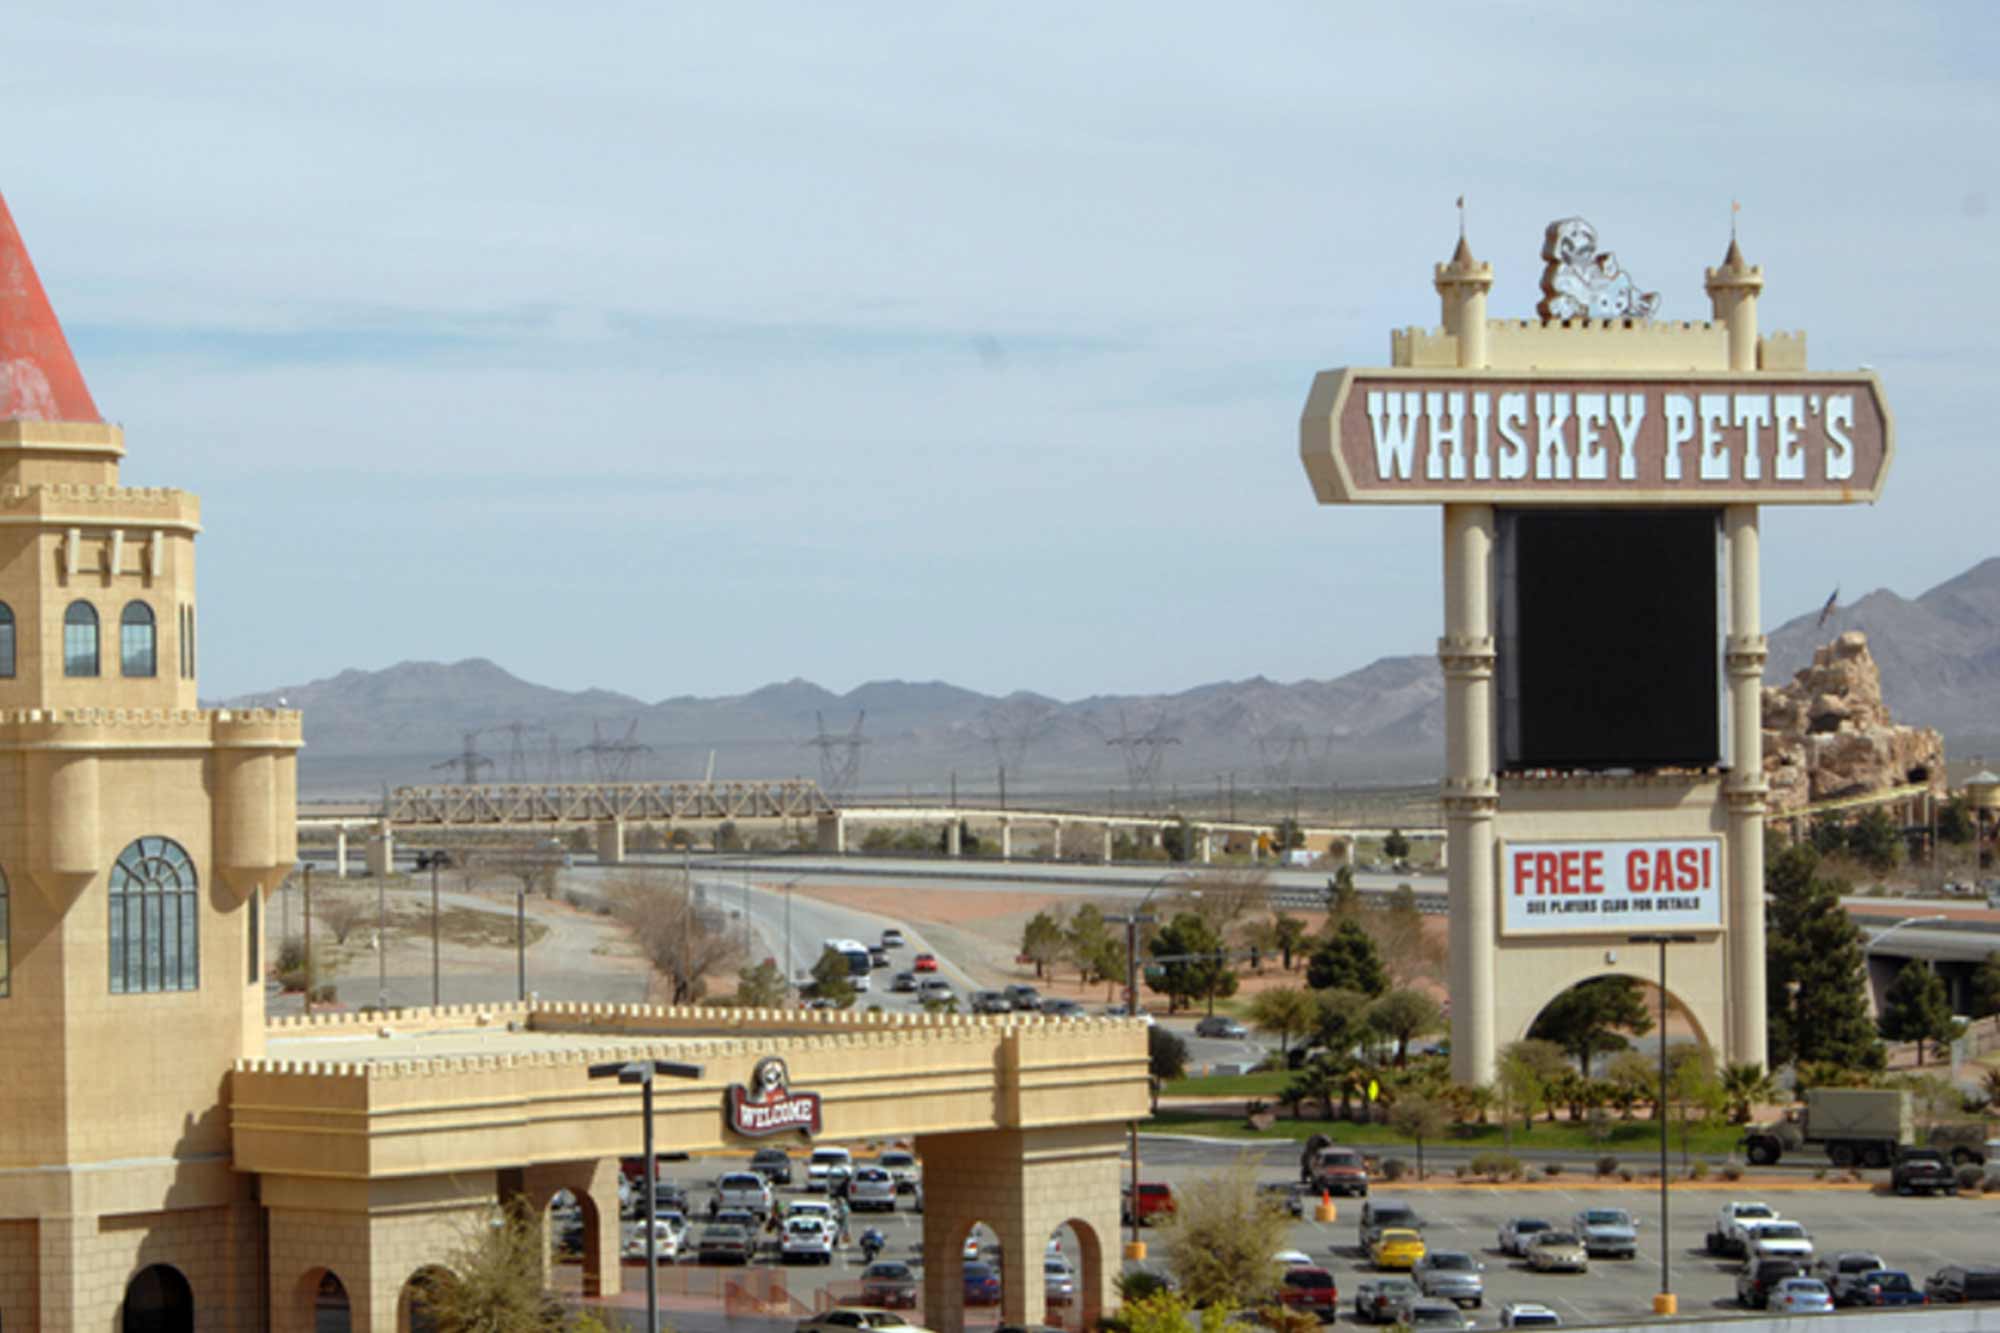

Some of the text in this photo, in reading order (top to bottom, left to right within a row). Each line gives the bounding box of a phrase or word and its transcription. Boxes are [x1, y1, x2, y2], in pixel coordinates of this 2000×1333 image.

[1366, 390, 1855, 480] WHISKEY PETE'S
[1513, 847, 1712, 896] FREE GAS!
[1632, 897, 1653, 911] FOR
[1656, 896, 1700, 911] DETAILS
[740, 1097, 814, 1129] WELCOME
